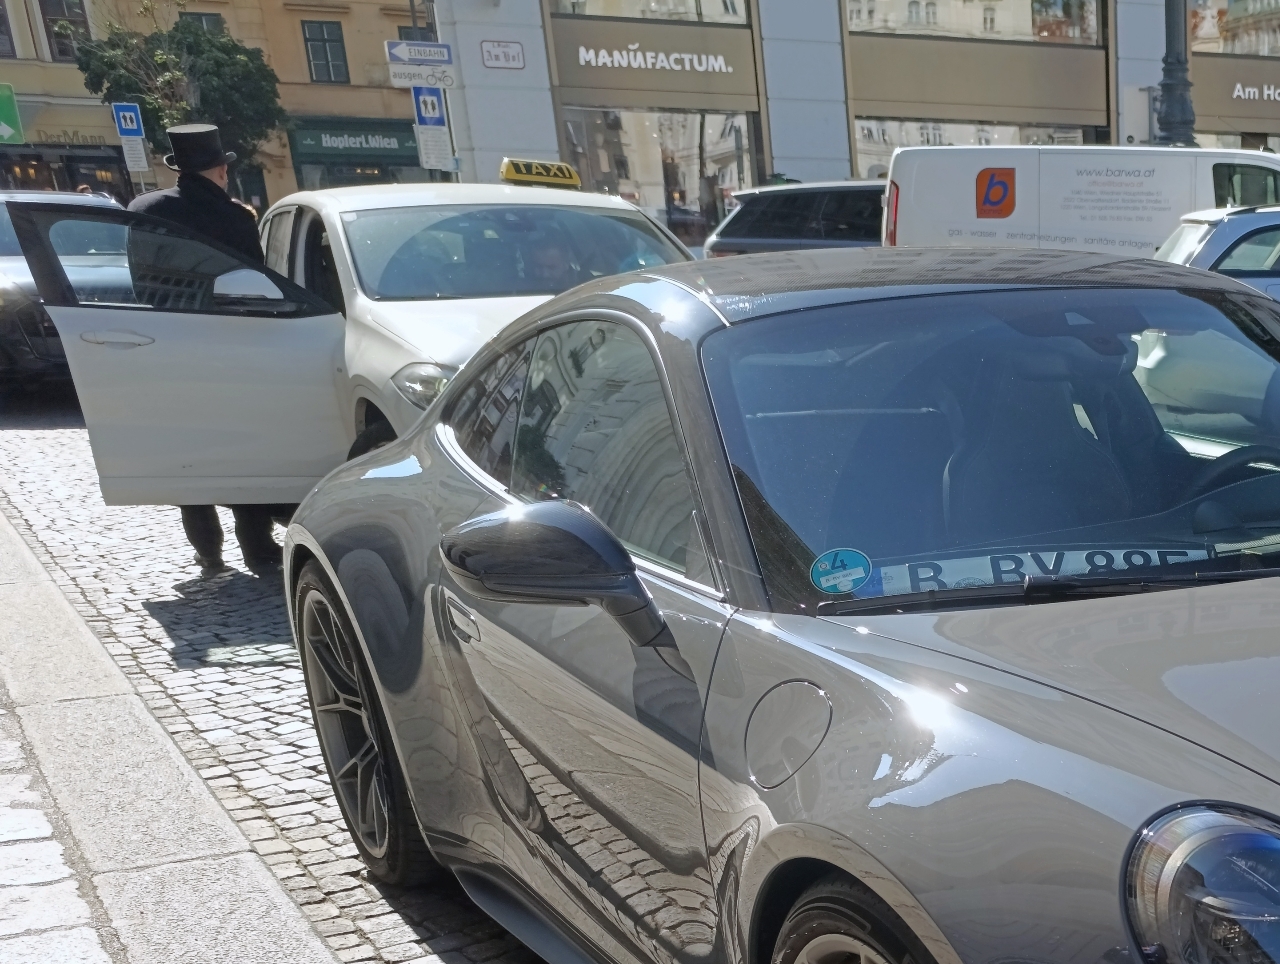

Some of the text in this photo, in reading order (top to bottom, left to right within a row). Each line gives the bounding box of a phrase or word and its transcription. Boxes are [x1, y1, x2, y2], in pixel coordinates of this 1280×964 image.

[408, 47, 446, 59] EINBAHN
[392, 70, 426, 82] ausgen.
[1232, 82, 1259, 100] Am
[513, 161, 571, 178] TAXI
[1075, 167, 1156, 178] www.barwa.at
[982, 172, 1009, 207] b
[948, 229, 963, 238] gas
[970, 230, 997, 238] wasser
[1118, 239, 1154, 250] anlagen
[831, 552, 848, 570] 4
